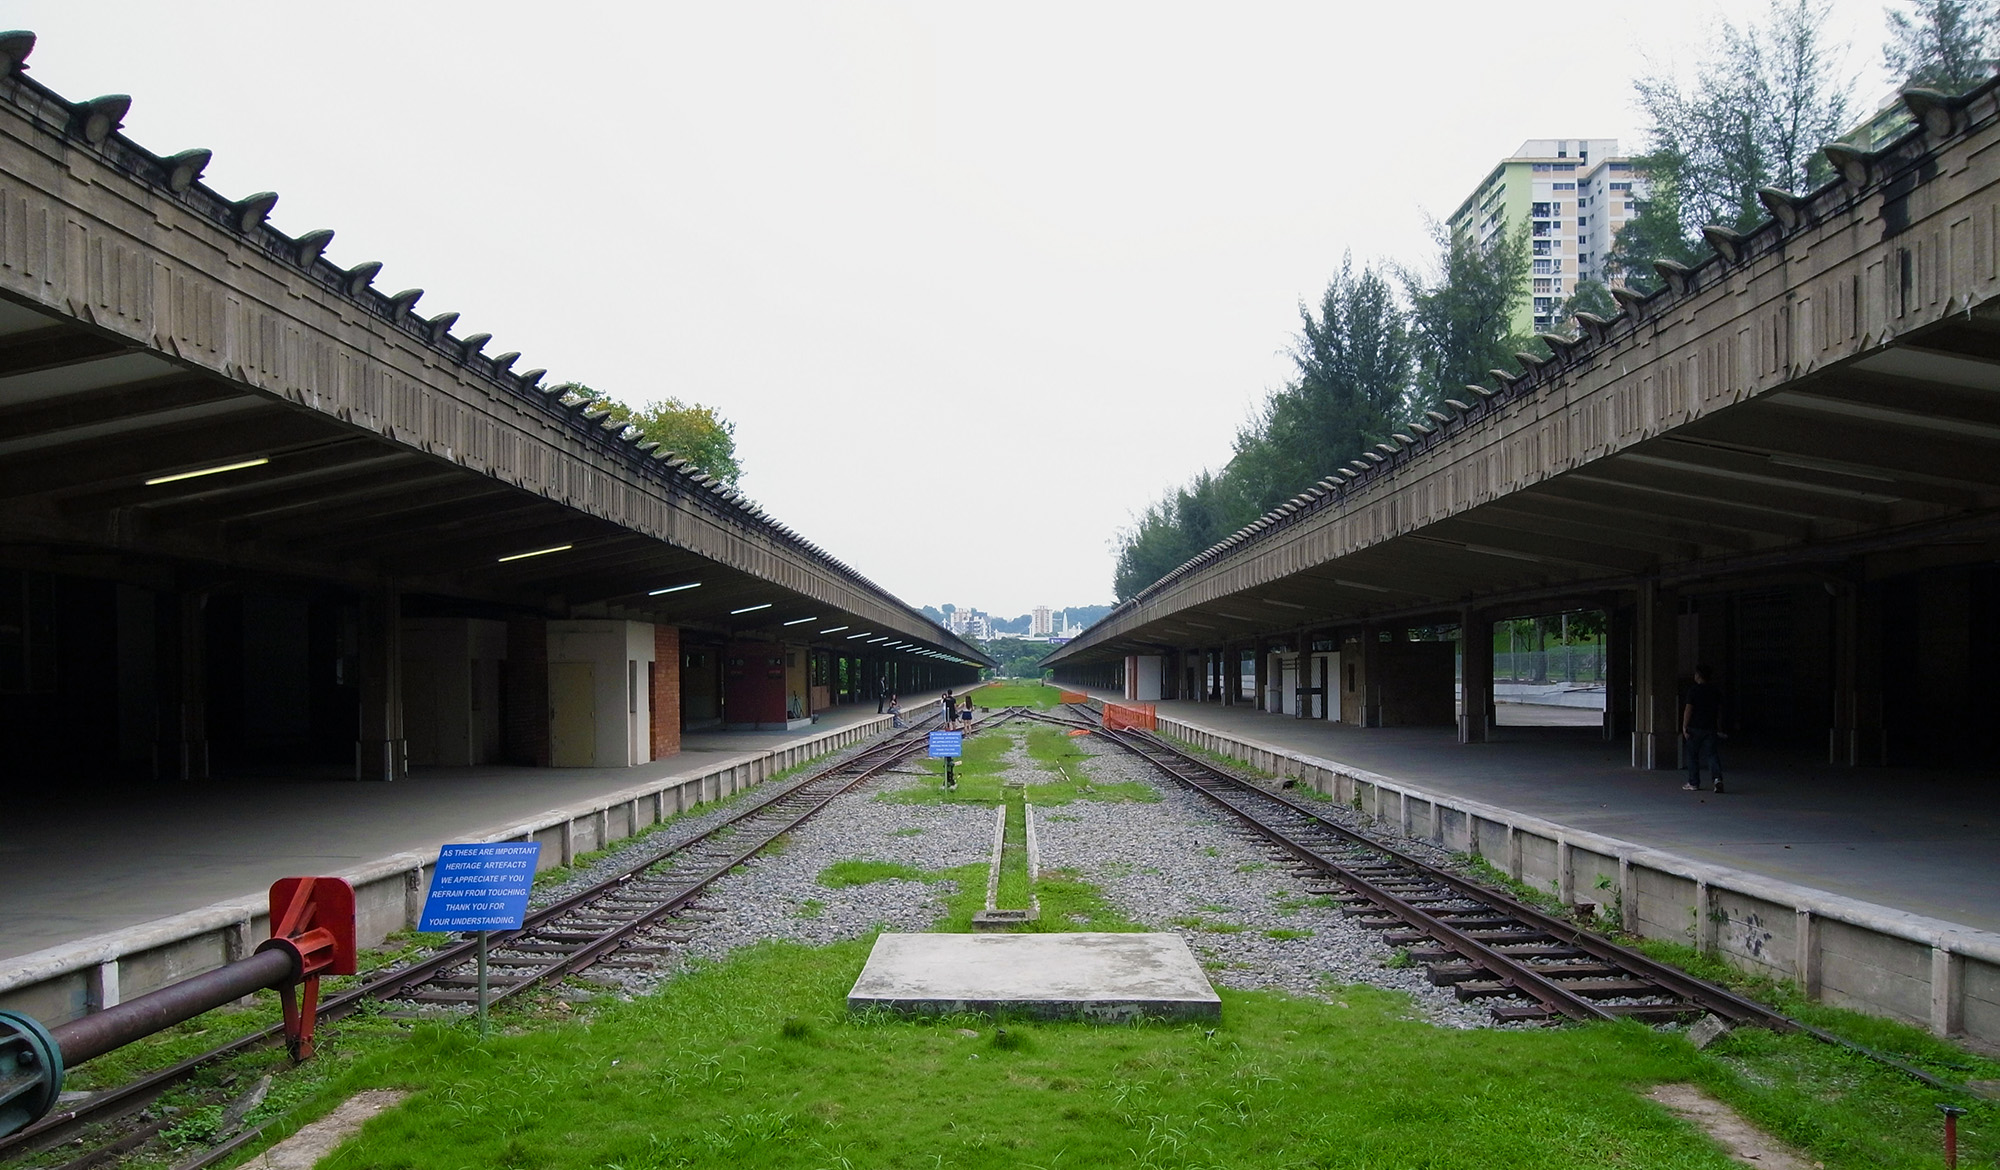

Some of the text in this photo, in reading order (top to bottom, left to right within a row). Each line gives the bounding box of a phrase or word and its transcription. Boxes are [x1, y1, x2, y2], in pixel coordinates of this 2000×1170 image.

[442, 847, 537, 857] AS THESE ARE IMPORTANT
[445, 861, 527, 870] HERITAGE ARTEFACTS
[441, 876, 453, 884] WE
[453, 875, 499, 884] APPRECIATE
[431, 888, 528, 898] REFRAIN FROM TOUCHING.
[445, 902, 505, 911] THANK YOU FOR
[429, 916, 516, 926] YOUR UNDERSTANDING.
